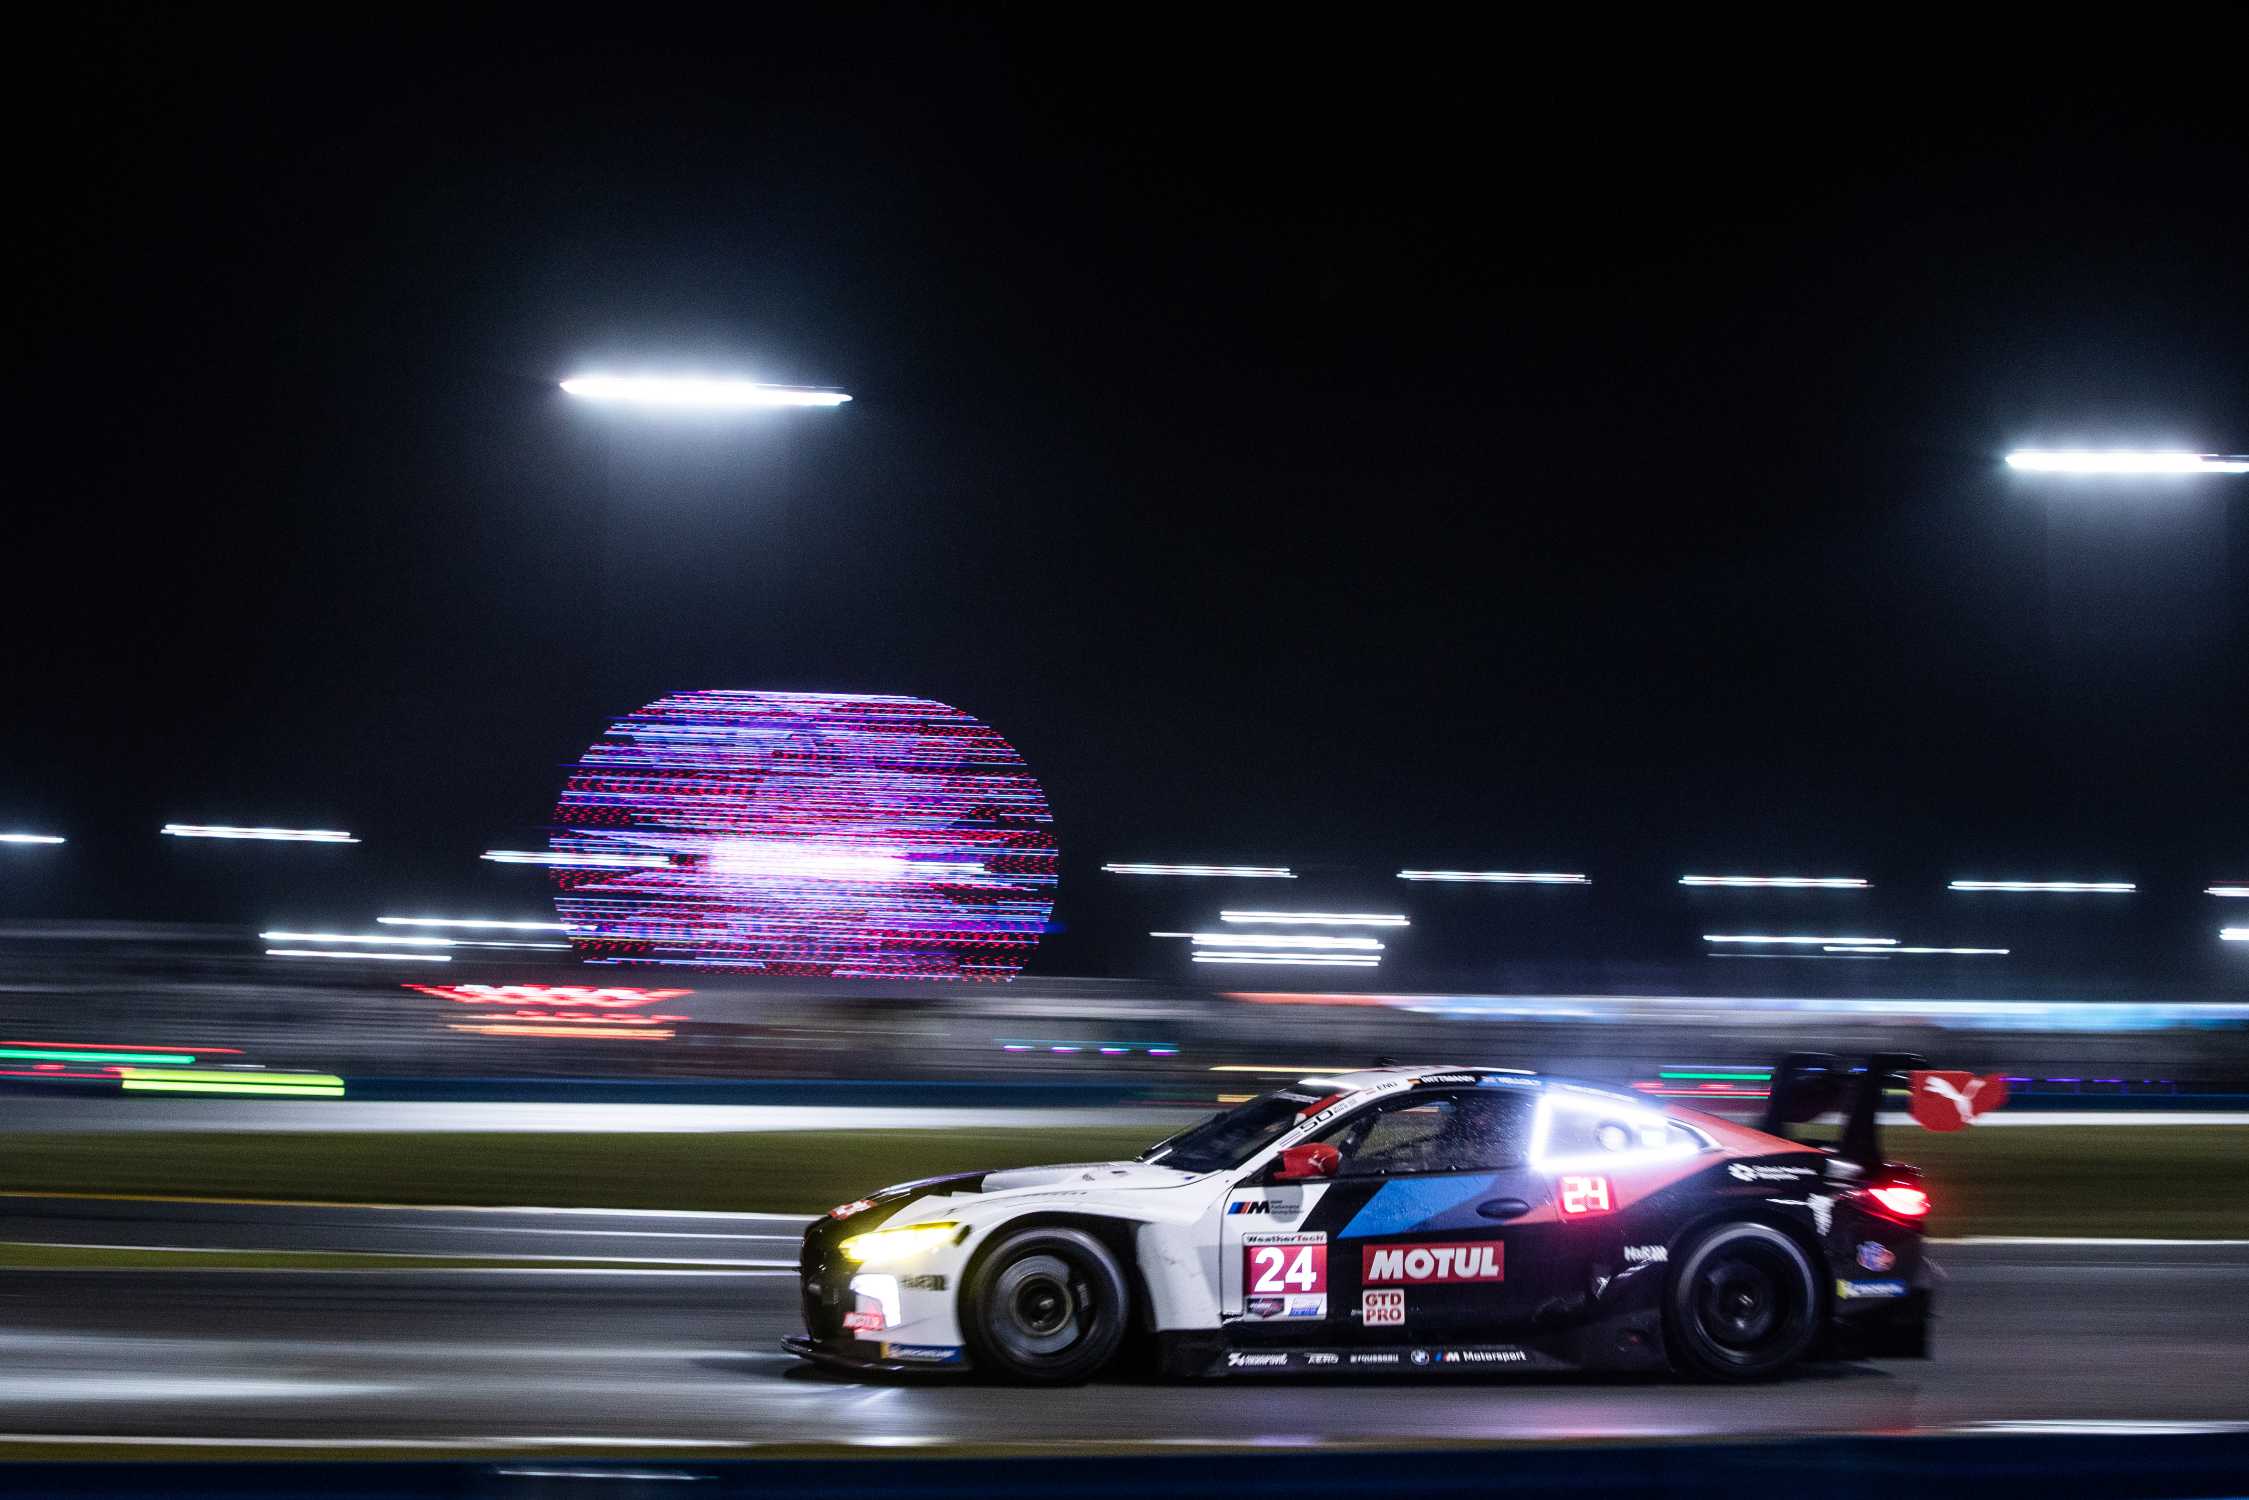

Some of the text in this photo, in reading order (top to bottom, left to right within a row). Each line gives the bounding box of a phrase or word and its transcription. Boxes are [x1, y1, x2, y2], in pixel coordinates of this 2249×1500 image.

[1562, 1176, 1609, 1214] 24
[1253, 1246, 1317, 1293] 24
[1368, 1246, 1499, 1281] MOTUL
[1365, 1292, 1401, 1307] GTD
[1365, 1308, 1401, 1322] PRO
[1463, 1349, 1526, 1363] Motorsport
